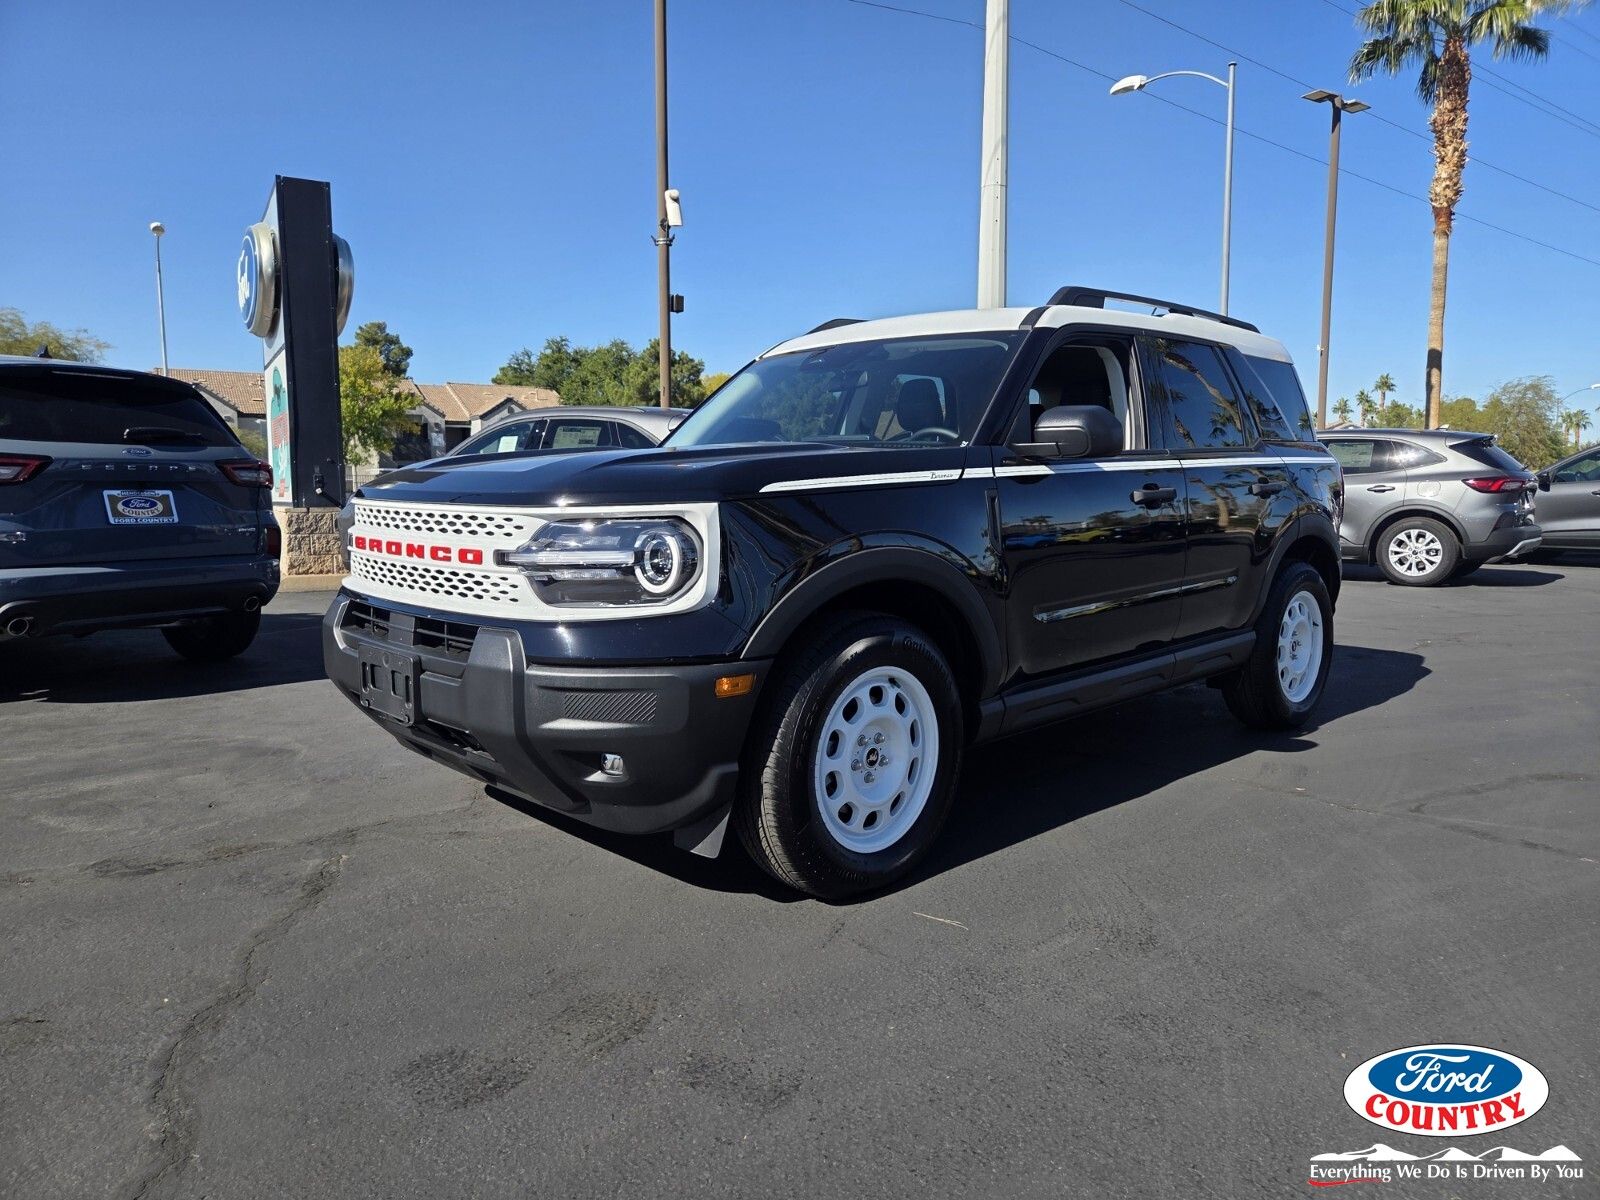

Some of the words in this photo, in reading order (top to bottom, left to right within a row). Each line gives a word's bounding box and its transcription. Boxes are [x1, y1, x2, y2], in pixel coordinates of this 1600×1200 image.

[129, 499, 151, 508] Ford
[122, 506, 161, 516] COUNTRY
[354, 535, 484, 566] BRONCO
